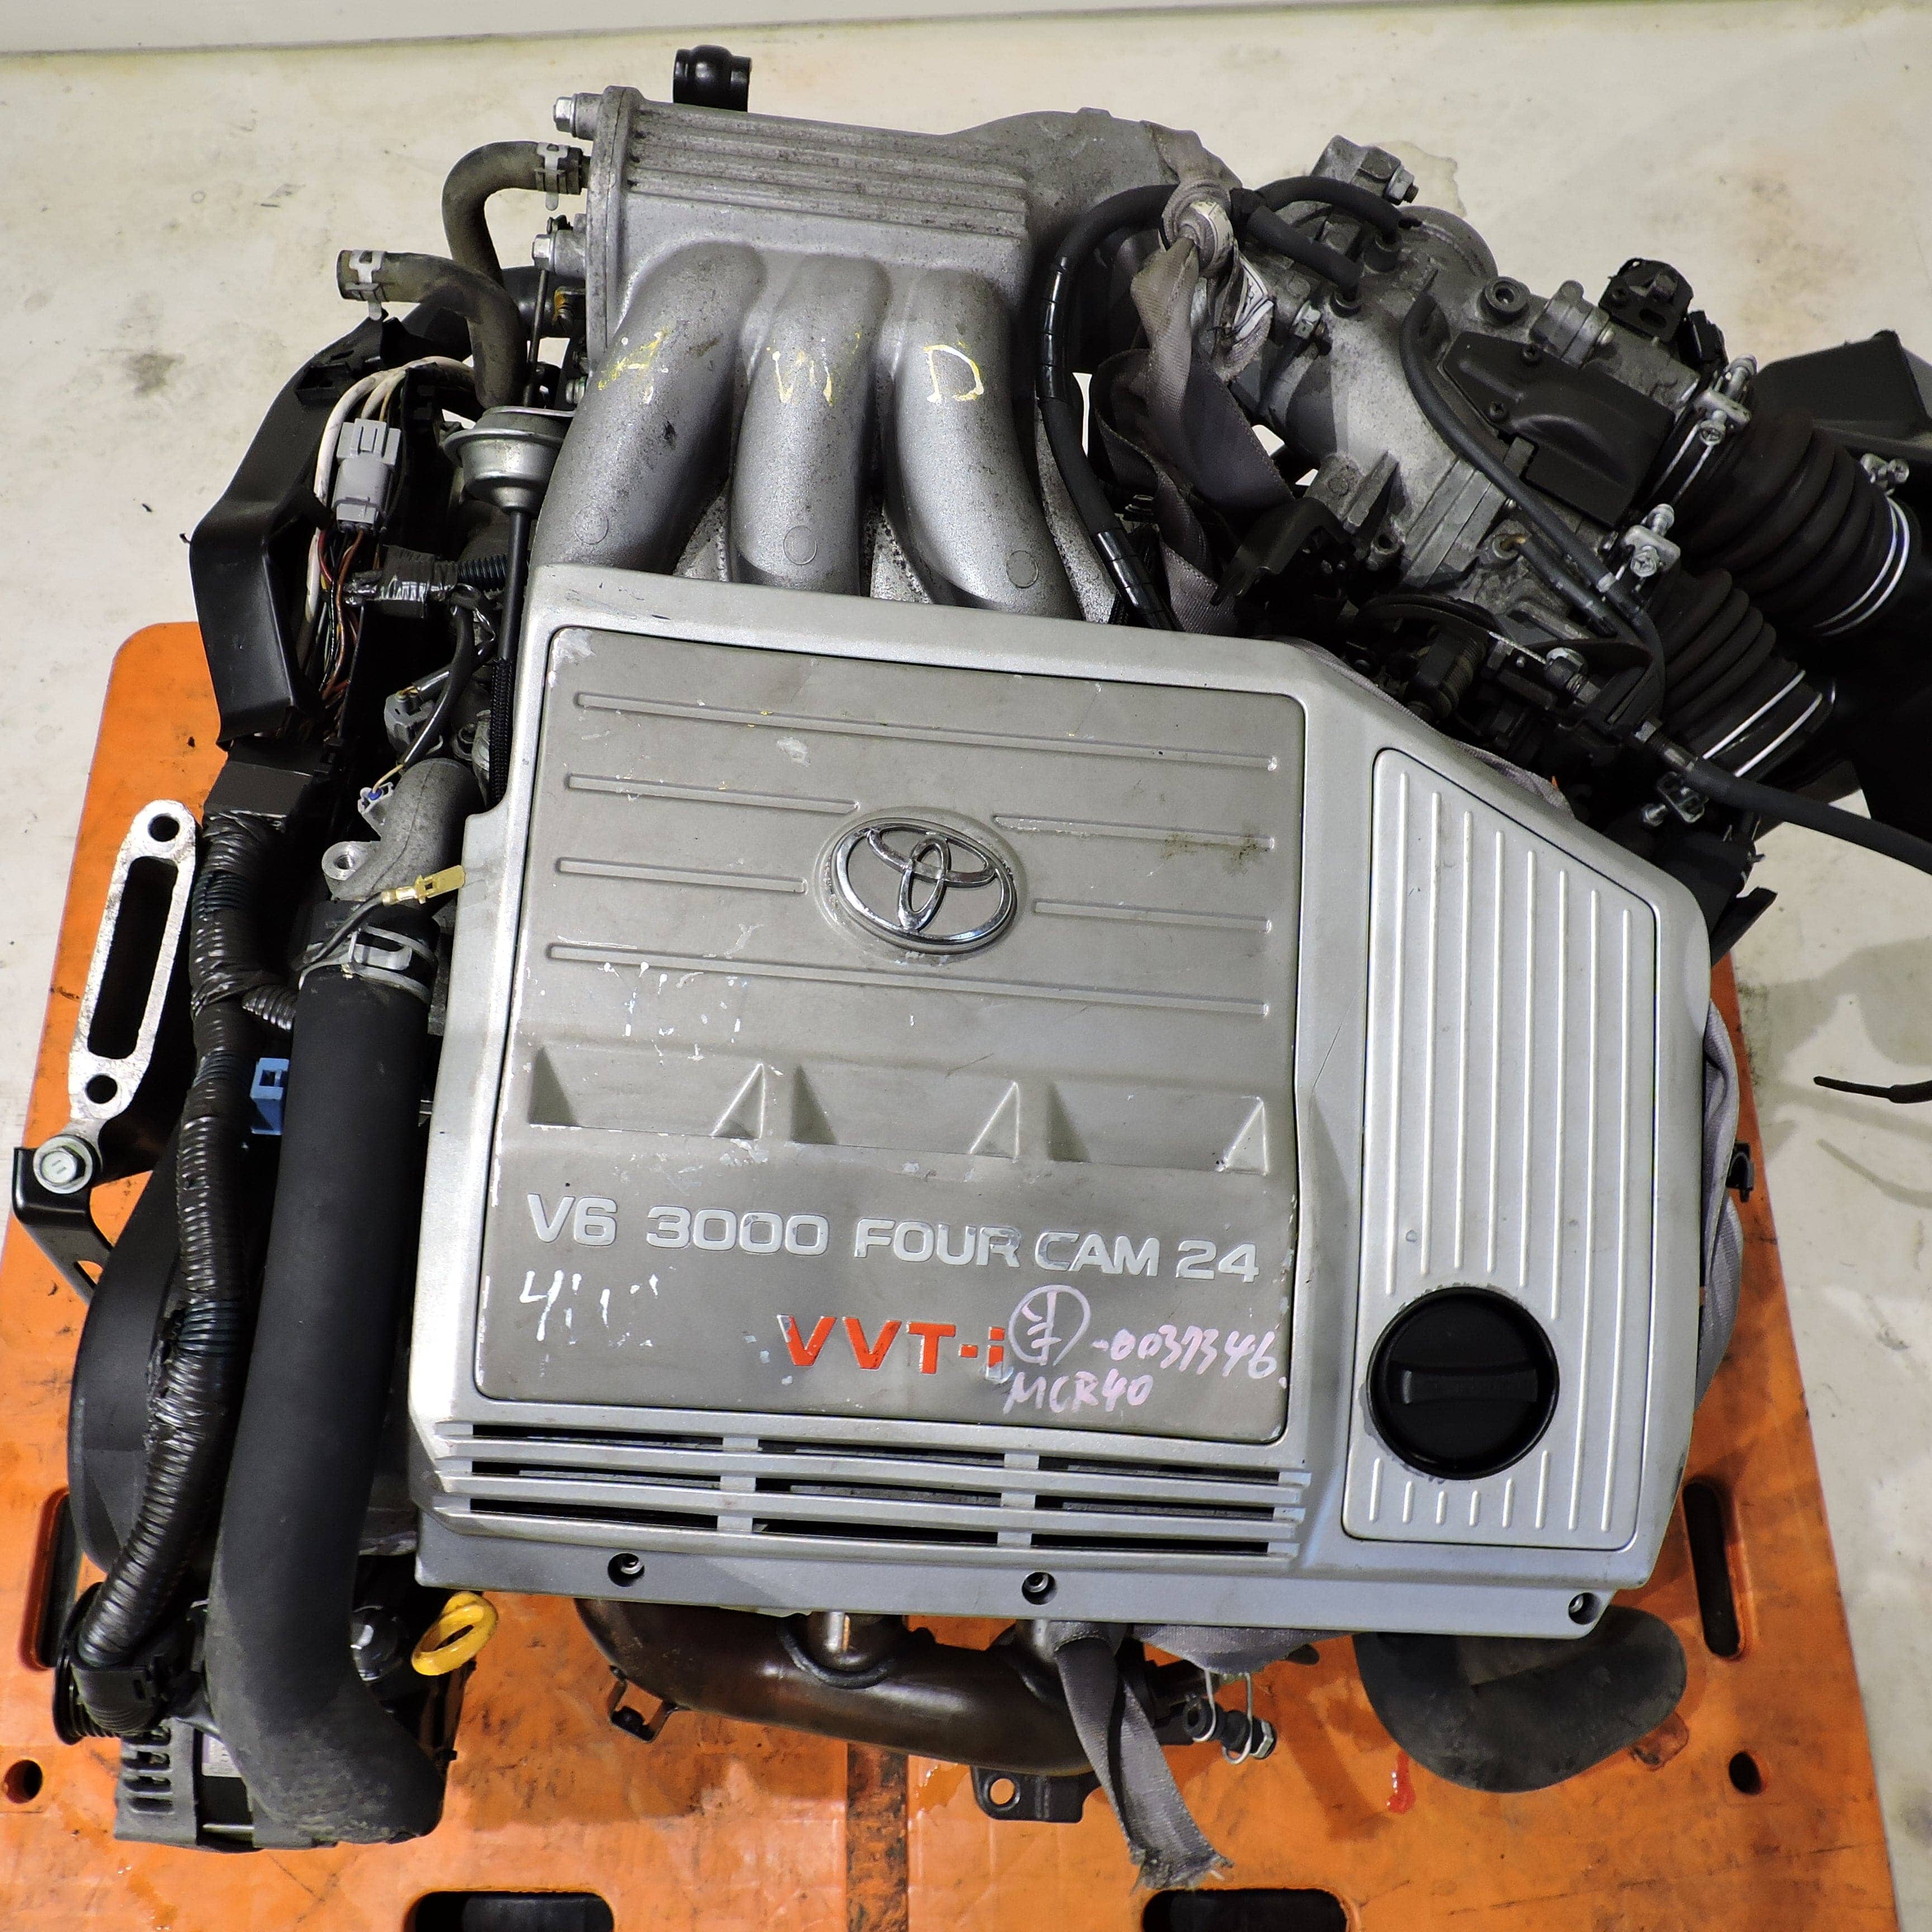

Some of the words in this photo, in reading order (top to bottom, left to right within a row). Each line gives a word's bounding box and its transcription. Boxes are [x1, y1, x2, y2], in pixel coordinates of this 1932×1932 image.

[528, 1194, 618, 1246] V6
[646, 1206, 830, 1257] 3000
[854, 1218, 1021, 1268] FOUR
[1035, 1231, 1161, 1277] CAM
[1176, 1239, 1260, 1284] 24
[777, 1314, 1006, 1380] VVT-i
[1003, 1368, 1153, 1414] MCR40
